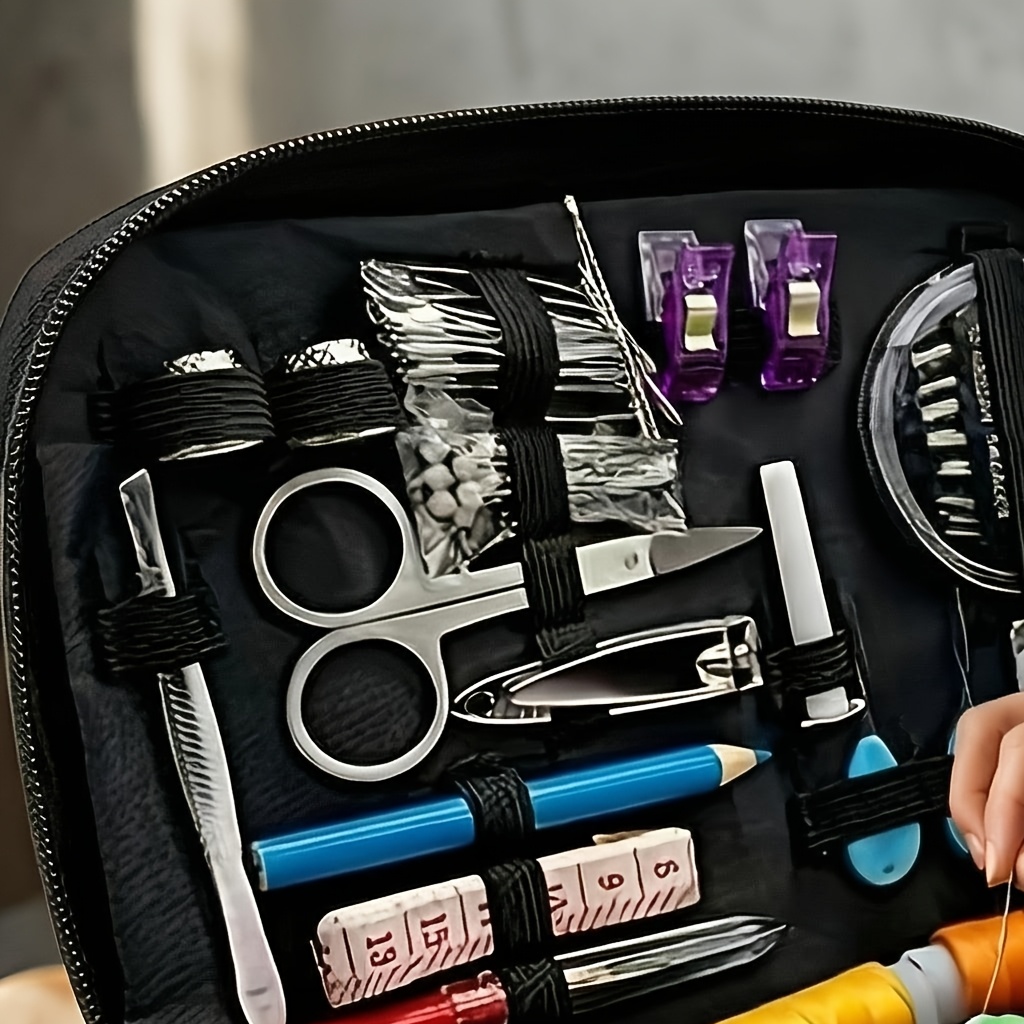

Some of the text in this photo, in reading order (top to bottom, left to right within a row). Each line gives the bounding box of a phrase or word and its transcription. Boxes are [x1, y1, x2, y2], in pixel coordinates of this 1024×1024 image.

[597, 873, 625, 891] 9
[366, 931, 397, 968] 19
[420, 912, 451, 950] 15
